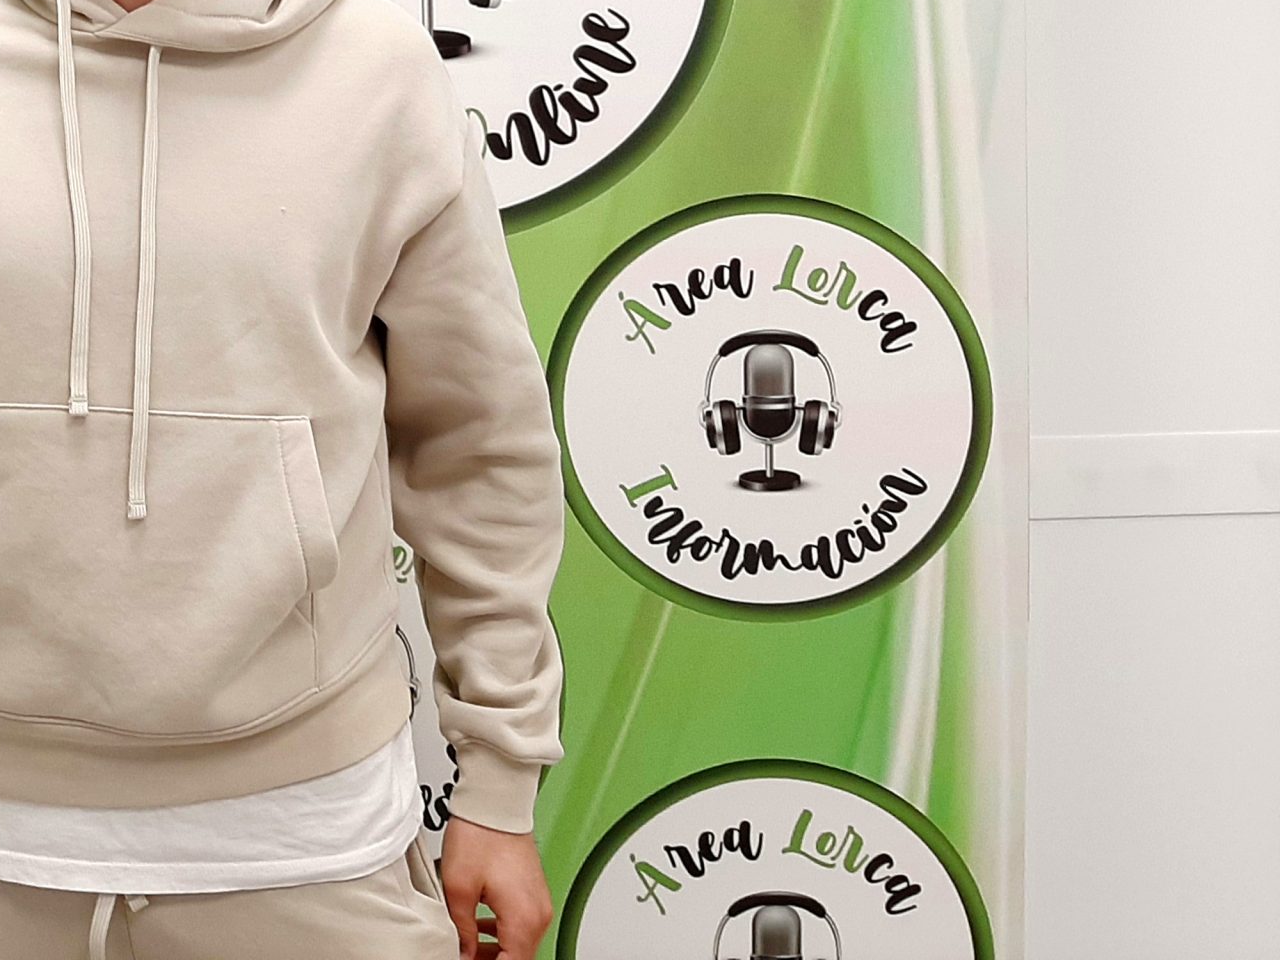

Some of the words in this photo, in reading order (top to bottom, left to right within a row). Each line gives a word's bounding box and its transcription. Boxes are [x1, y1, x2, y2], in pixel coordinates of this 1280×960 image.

[618, 257, 754, 355] Área
[773, 245, 918, 353] Lorca
[620, 464, 928, 580] Información
[629, 820, 764, 915] Área
[781, 808, 922, 915] Lorca
